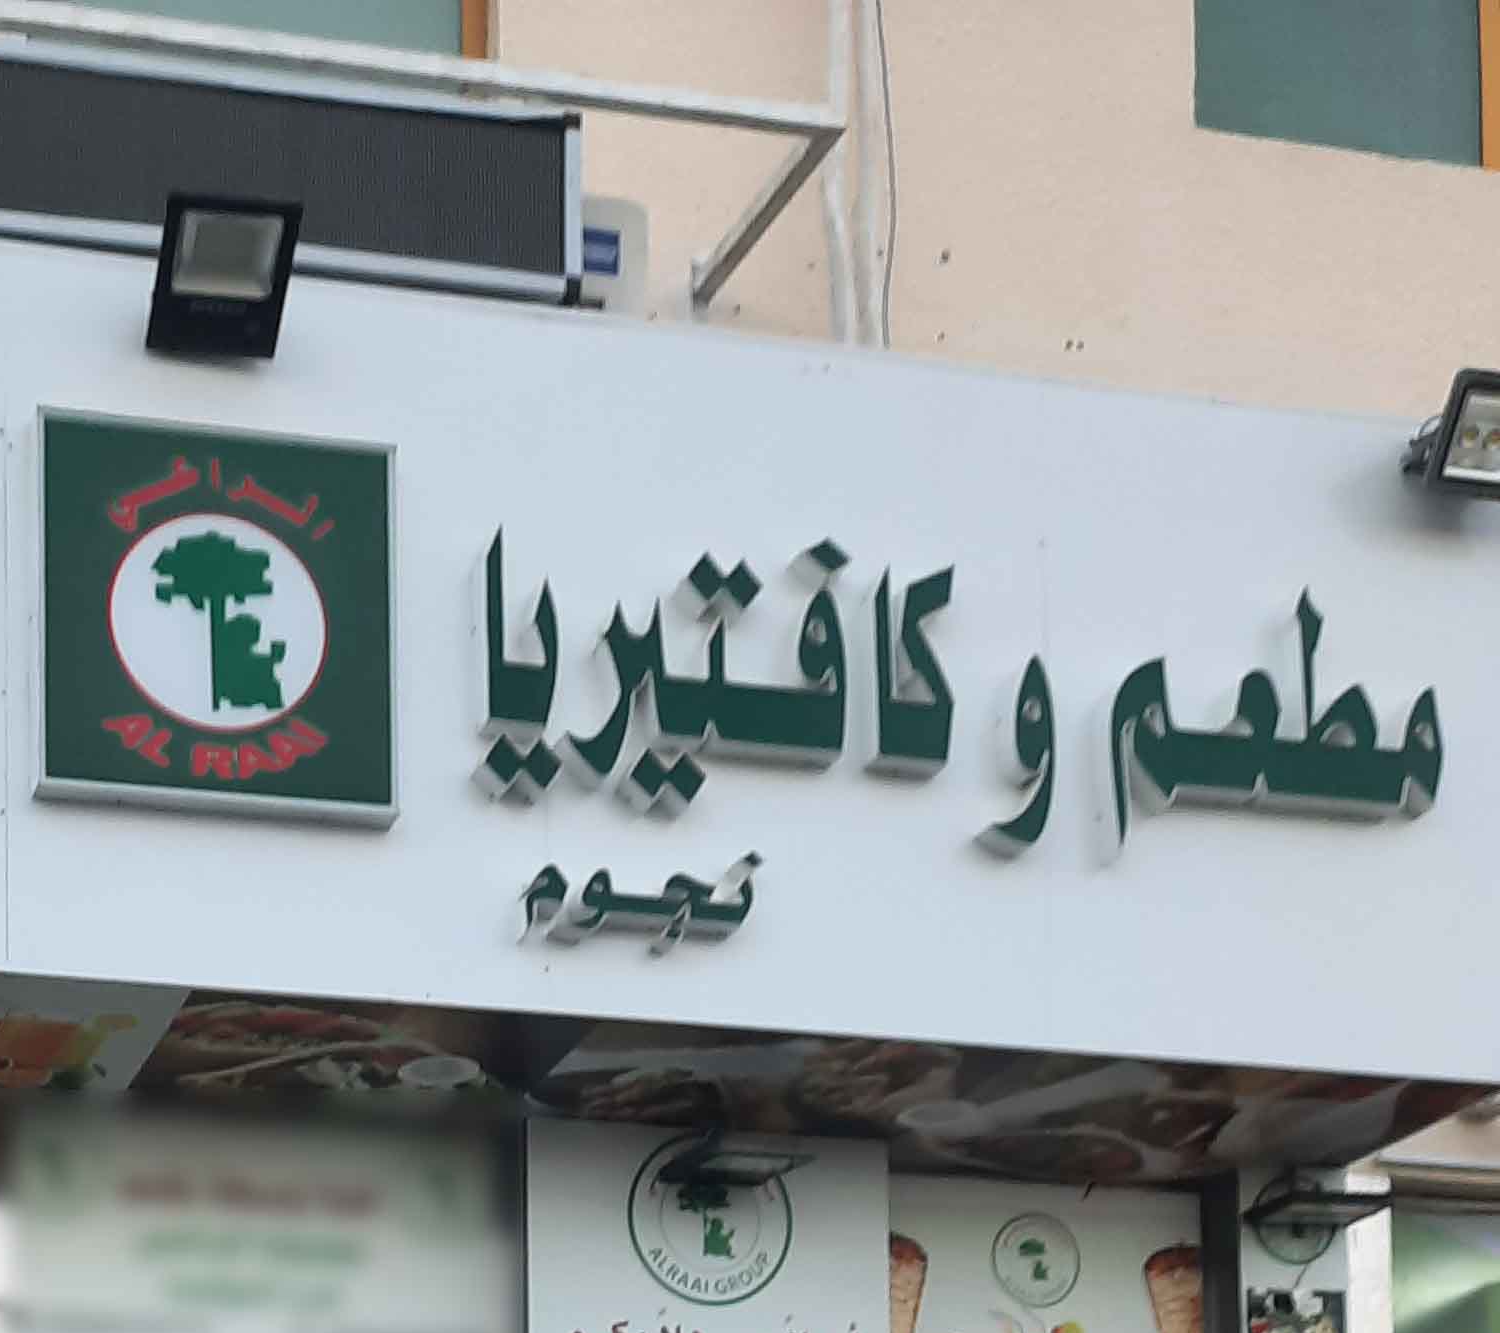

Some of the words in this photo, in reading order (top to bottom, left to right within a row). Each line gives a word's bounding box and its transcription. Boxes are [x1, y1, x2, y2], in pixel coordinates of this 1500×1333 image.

[101, 713, 174, 768] AL
[189, 717, 329, 780] RAAI
[1106, 588, 1444, 850] مطعم
[518, 851, 762, 952] نجوم
